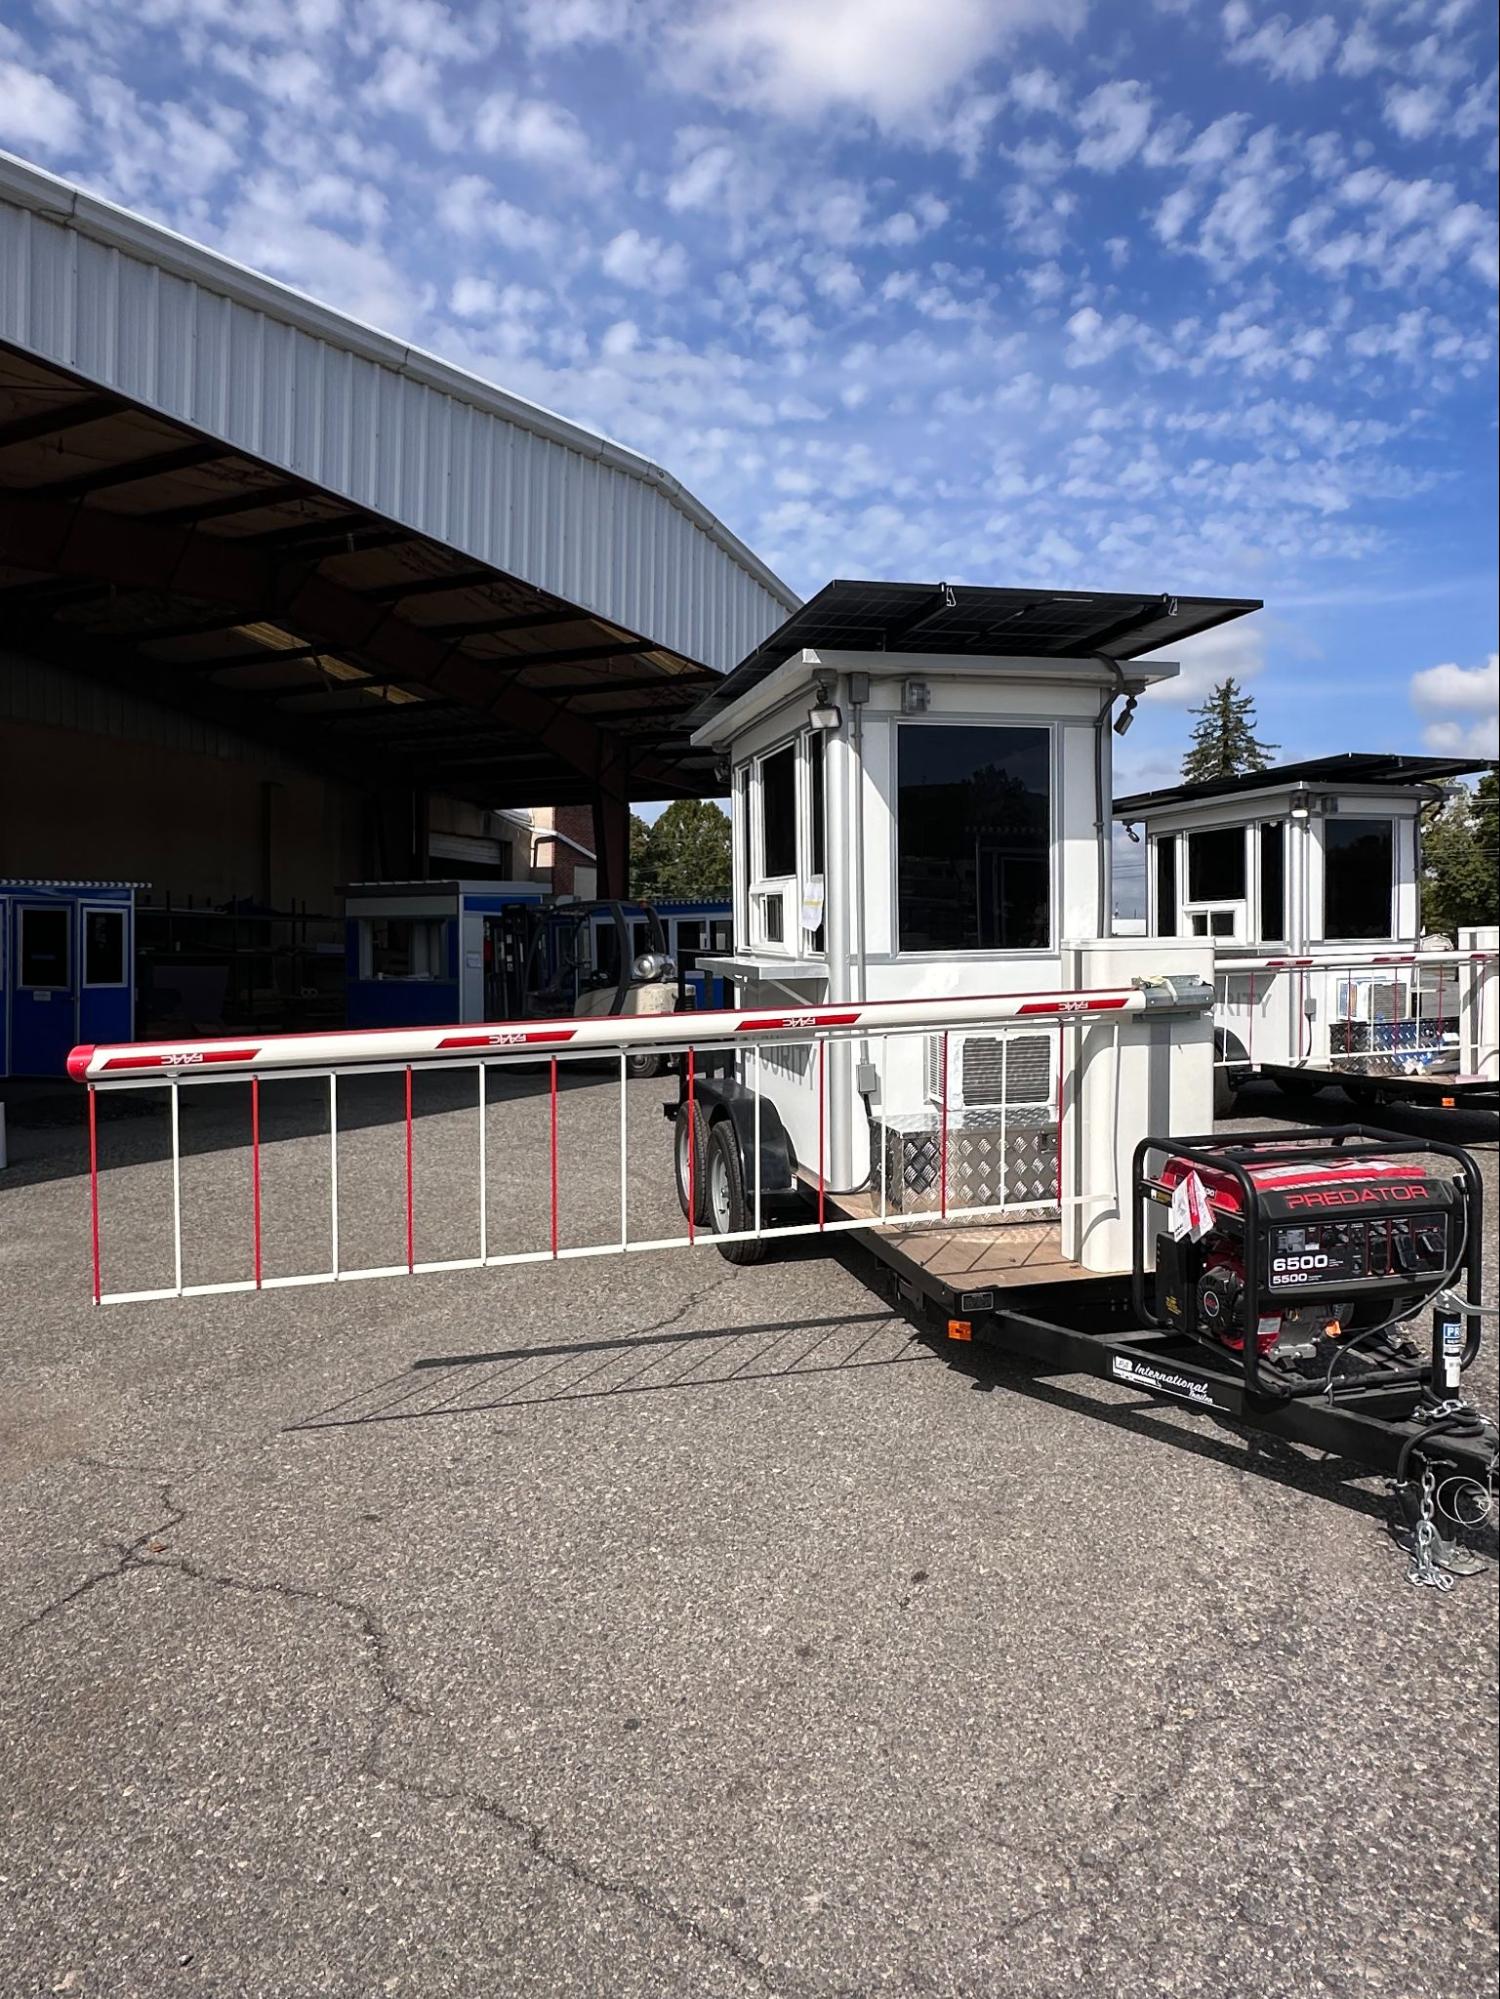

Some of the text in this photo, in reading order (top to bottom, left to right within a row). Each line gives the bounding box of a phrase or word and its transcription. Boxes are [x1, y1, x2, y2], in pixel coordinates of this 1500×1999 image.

[1057, 1000, 1089, 1011] FAAC
[782, 1016, 816, 1028] FAAC
[488, 1033, 527, 1045] FAAC
[160, 1053, 203, 1065] FAAC
[1285, 1185, 1429, 1209] PREDATOR
[1273, 1254, 1329, 1272] 6500
[1272, 1273, 1308, 1285] 5500
[1134, 1363, 1209, 1394] International
